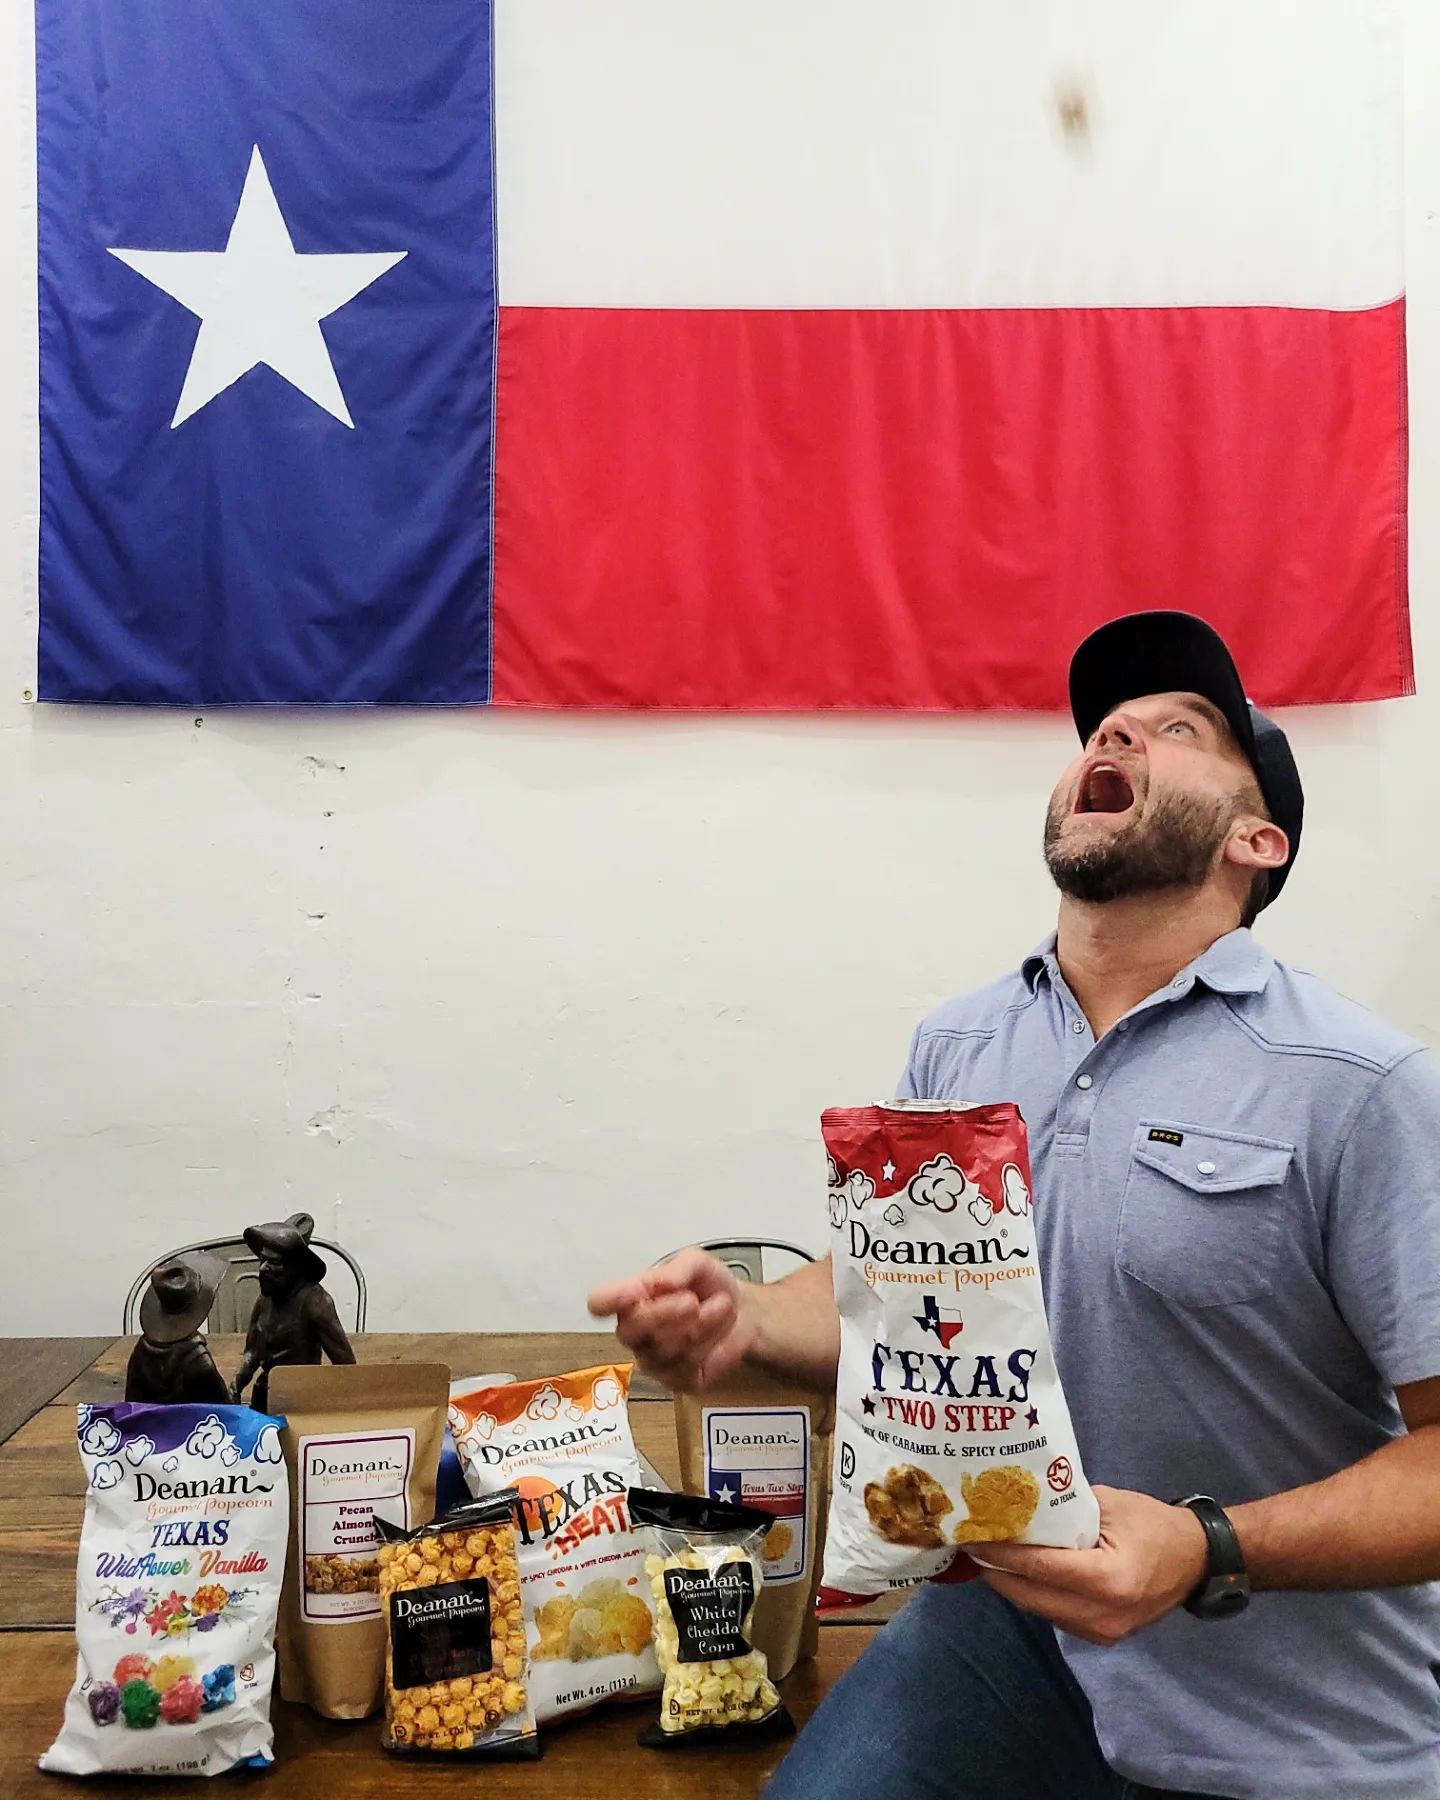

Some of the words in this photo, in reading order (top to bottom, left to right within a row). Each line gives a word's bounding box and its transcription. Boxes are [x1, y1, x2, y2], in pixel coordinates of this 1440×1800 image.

[864, 1261, 947, 1288] Gourmet
[954, 1265, 1036, 1292] Popcorn
[872, 1340, 1038, 1402] TEXAS
[881, 1396, 936, 1430] TWO
[944, 1404, 1017, 1432] STEP
[878, 1431, 890, 1443] OF
[892, 1435, 940, 1455] CARAMEL
[943, 1443, 956, 1457] &
[961, 1446, 996, 1457] SPICY
[1000, 1436, 1048, 1456] CHEDDAR
[743, 1483, 765, 1493] Texas
[767, 1483, 784, 1493] Two
[786, 1482, 804, 1494] Step
[204, 1497, 273, 1515] Popcorn
[339, 1506, 374, 1516] Pecan
[512, 1471, 627, 1546] TEXAS
[150, 1519, 231, 1548] TEXAS
[554, 1493, 628, 1556] HEAT
[199, 1550, 269, 1578] Vanilla
[530, 1571, 545, 1582] SPICY
[547, 1565, 573, 1577] CHEDDAR
[598, 1553, 622, 1564] CHEDDAR
[888, 1578, 909, 1588] Net
[408, 1611, 447, 1628] Gourmet
[449, 1605, 486, 1620] Popcorn
[690, 1605, 737, 1621] White
[698, 1641, 735, 1655] Corn
[556, 1694, 571, 1705] Net
[572, 1690, 587, 1701] Wt.
[589, 1687, 594, 1696] 4
[595, 1686, 608, 1694] oz.
[609, 1678, 627, 1692] (113
